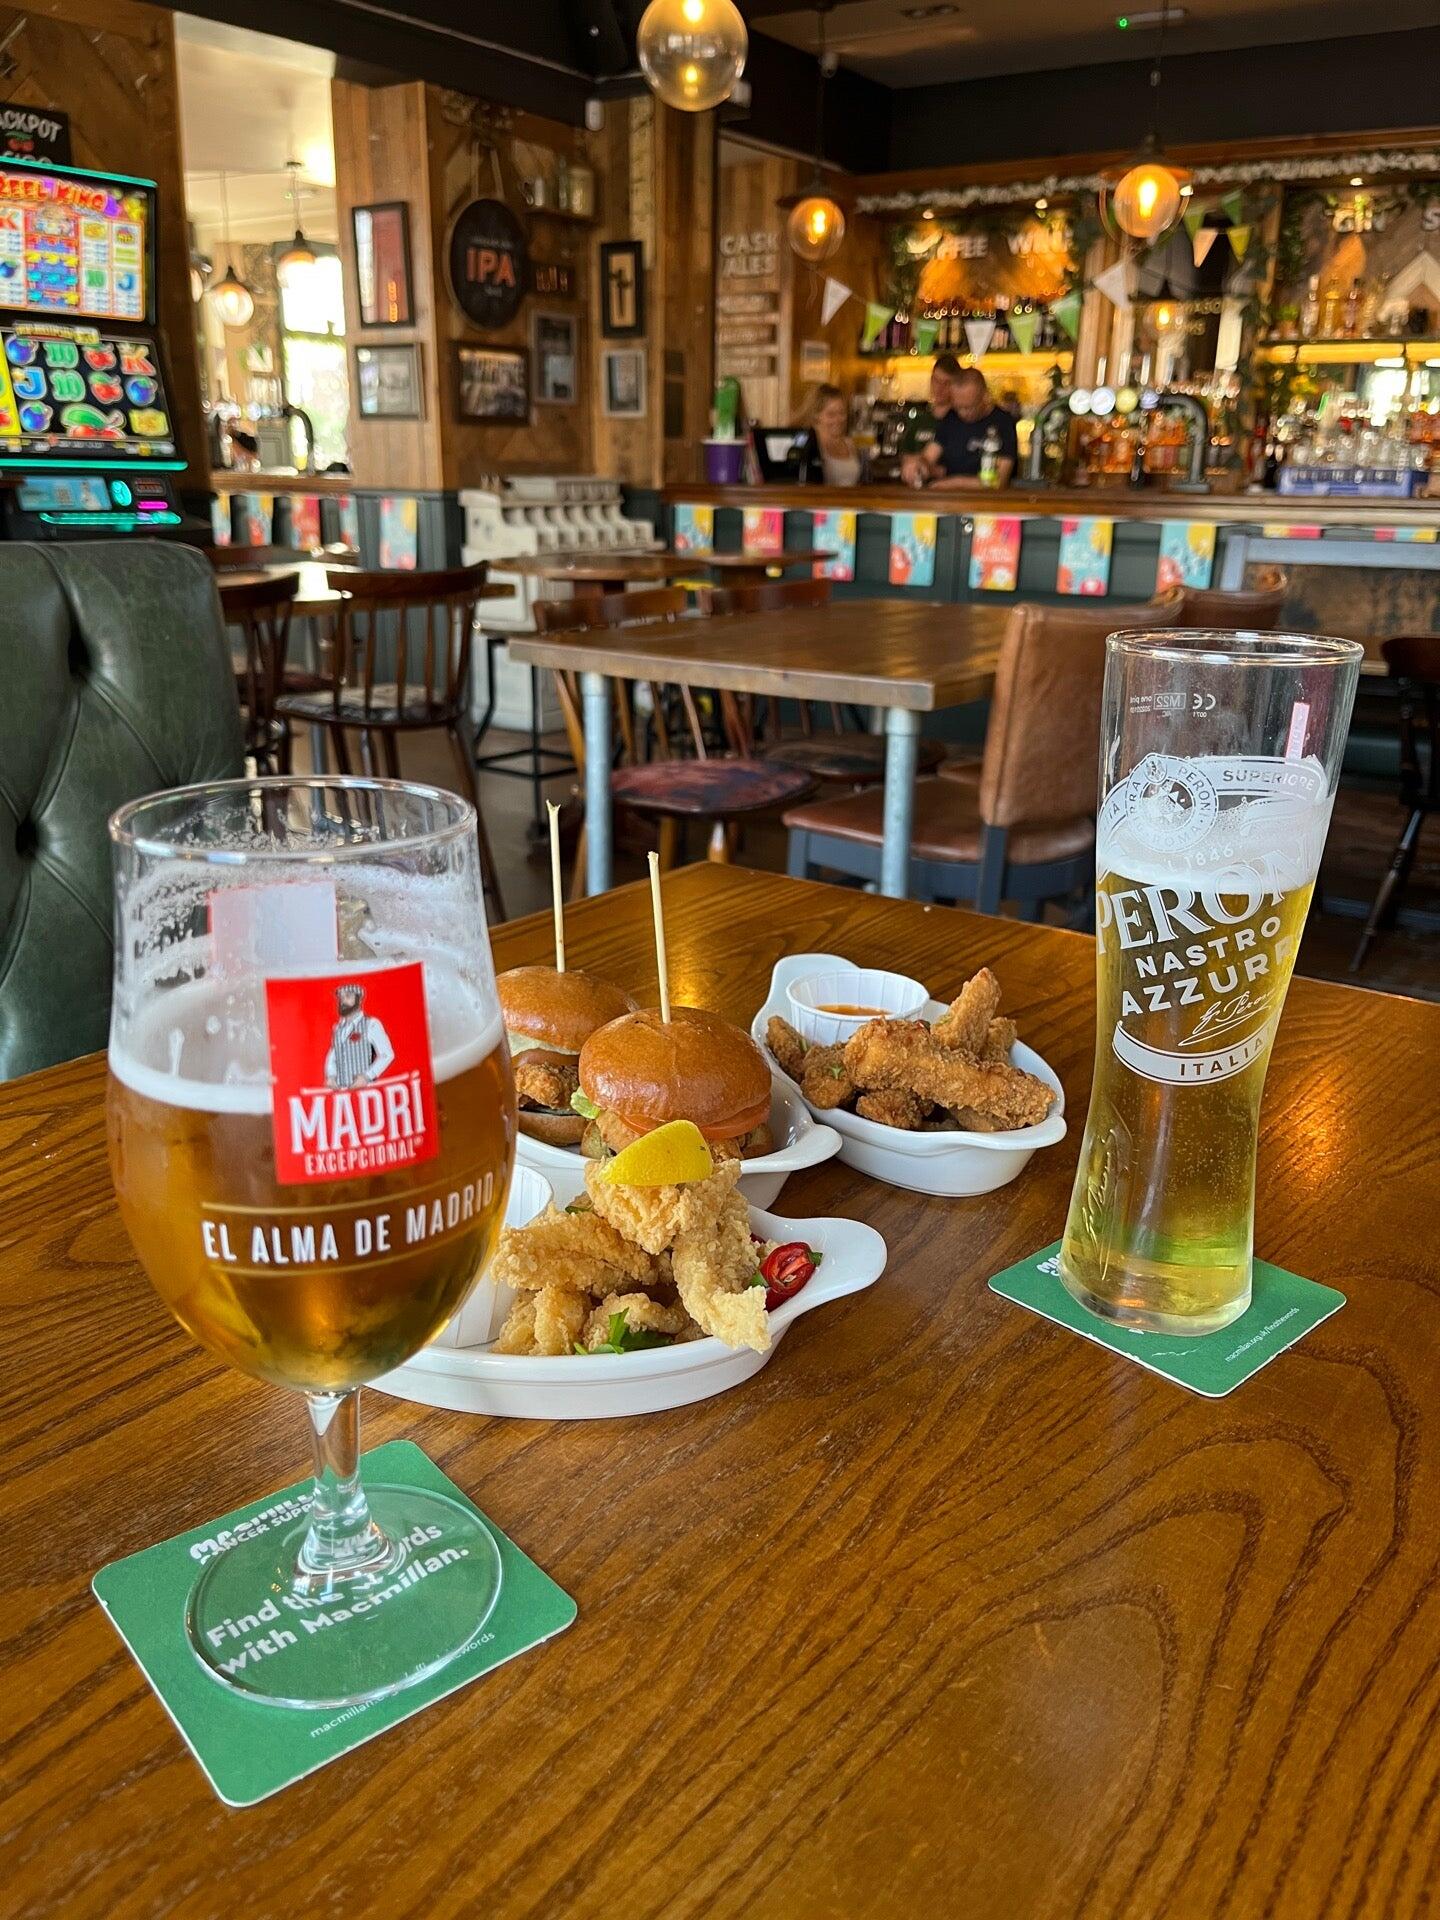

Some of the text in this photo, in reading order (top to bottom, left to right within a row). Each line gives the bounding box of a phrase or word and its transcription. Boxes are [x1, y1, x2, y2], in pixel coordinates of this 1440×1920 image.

[0, 110, 63, 143] ACKPOT
[55, 179, 107, 212] KING
[720, 233, 779, 255] CASK
[467, 247, 516, 288] IPA
[722, 255, 774, 276] ALES
[1178, 766, 1212, 817] PERONI
[1222, 768, 1315, 791] SUPERIORE
[1184, 844, 1234, 871] 1846
[1097, 843, 1302, 955] PERON
[1135, 916, 1281, 979] NASTRO
[1122, 933, 1298, 1017] AZZURR
[1180, 1037, 1265, 1076] ITALIA
[201, 1171, 494, 1265] EL ALMA DE MADRID
[271, 1503, 313, 1527] SUPP
[207, 1599, 281, 1648] Find
[218, 1547, 470, 1675] with Macmillan.
